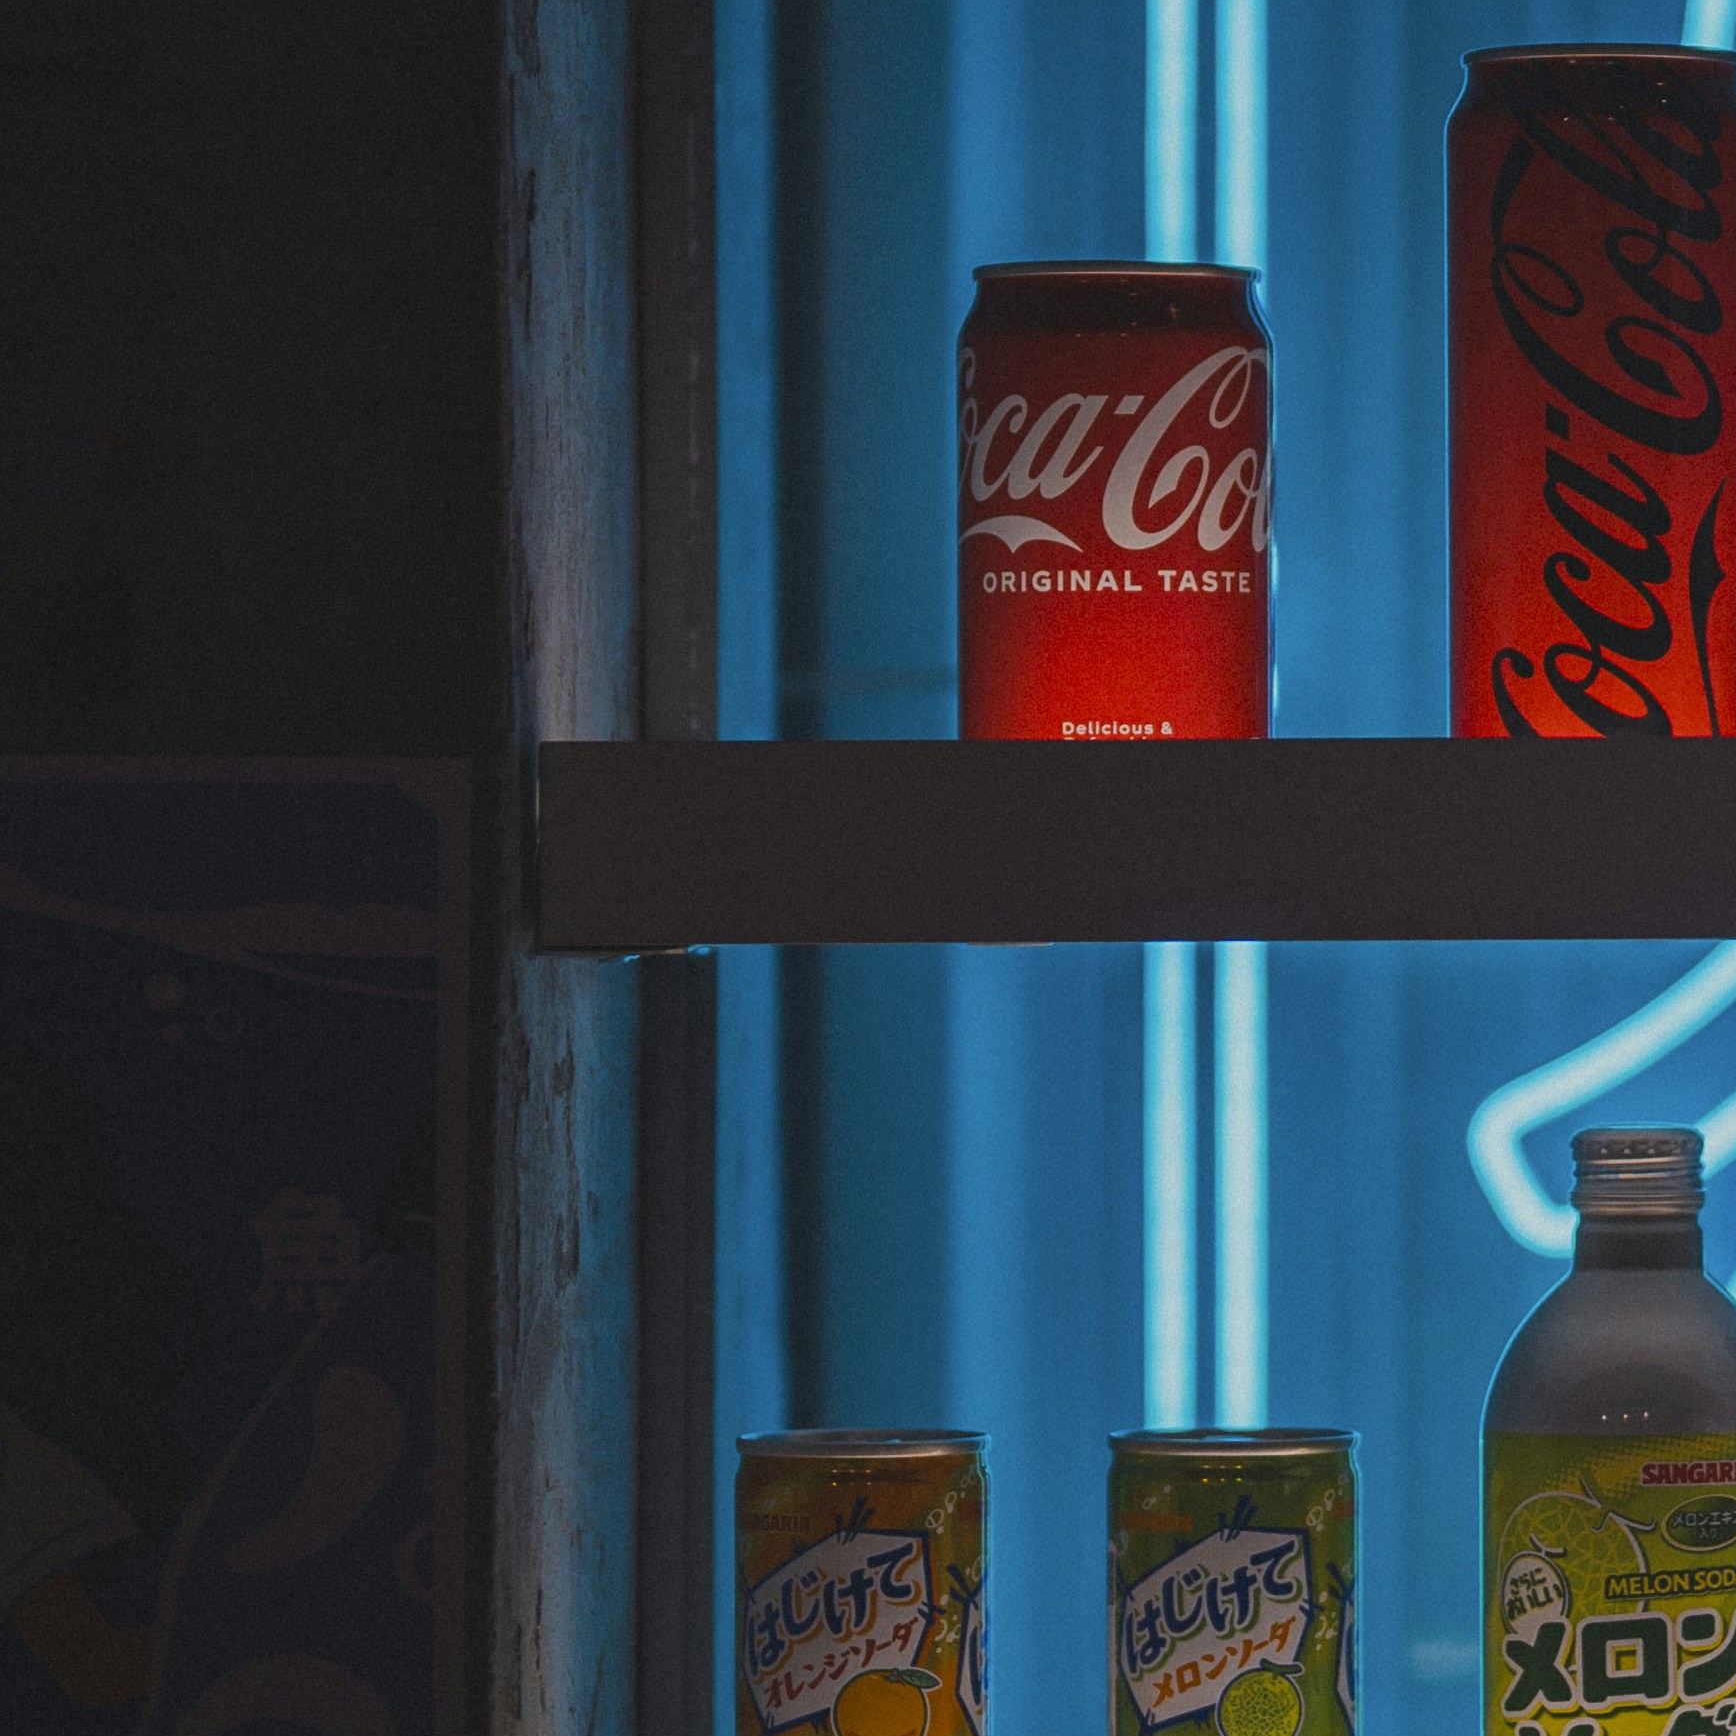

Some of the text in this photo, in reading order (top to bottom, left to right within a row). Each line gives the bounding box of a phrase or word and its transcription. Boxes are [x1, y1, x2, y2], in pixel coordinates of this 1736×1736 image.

[983, 570, 1251, 594] ORIGINAL TASTE
[1061, 721, 1174, 736] Delicious &
[1509, 1567, 1548, 1596] さらに
[1609, 1573, 1690, 1597] MELON
[751, 1541, 915, 1677] はじけて
[1124, 1540, 1298, 1676] はじけて
[1506, 1584, 1563, 1616] おいしい
[766, 1616, 919, 1709] オレンジソーダ
[1152, 1615, 1297, 1708] メロンソーダ
